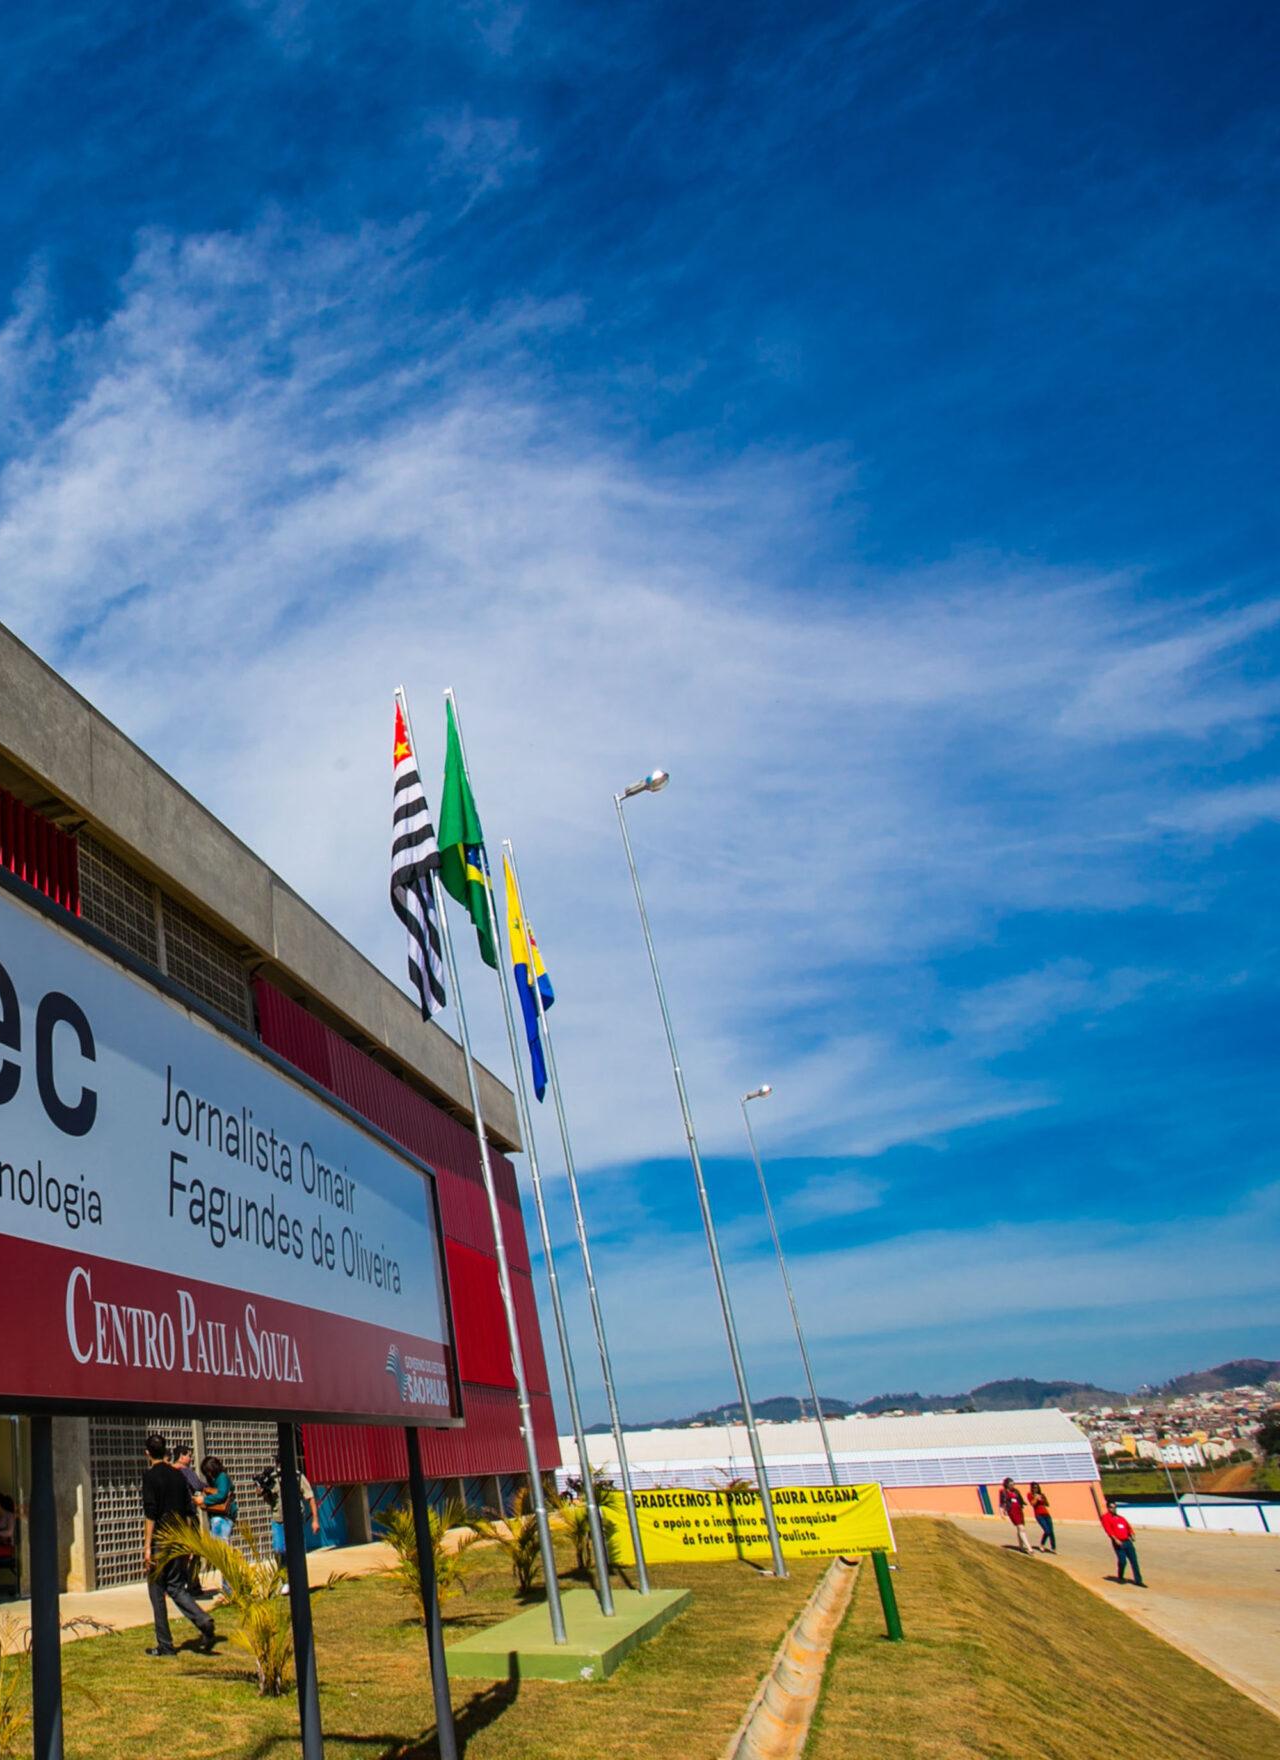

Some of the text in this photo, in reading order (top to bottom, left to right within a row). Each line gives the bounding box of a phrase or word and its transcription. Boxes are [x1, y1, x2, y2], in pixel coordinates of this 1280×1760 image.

[162, 1064, 356, 1215] Jornalista Omair
[169, 1150, 402, 1295] Fagundes de Oliveira
[65, 1266, 304, 1384] CENTRO PAULA SOUZA
[633, 1493, 711, 1508] GRADECEMOS
[653, 1512, 837, 1531] o apoio e o incentivo nta conquista
[682, 1533, 695, 1545] da
[697, 1533, 724, 1544] Fatec
